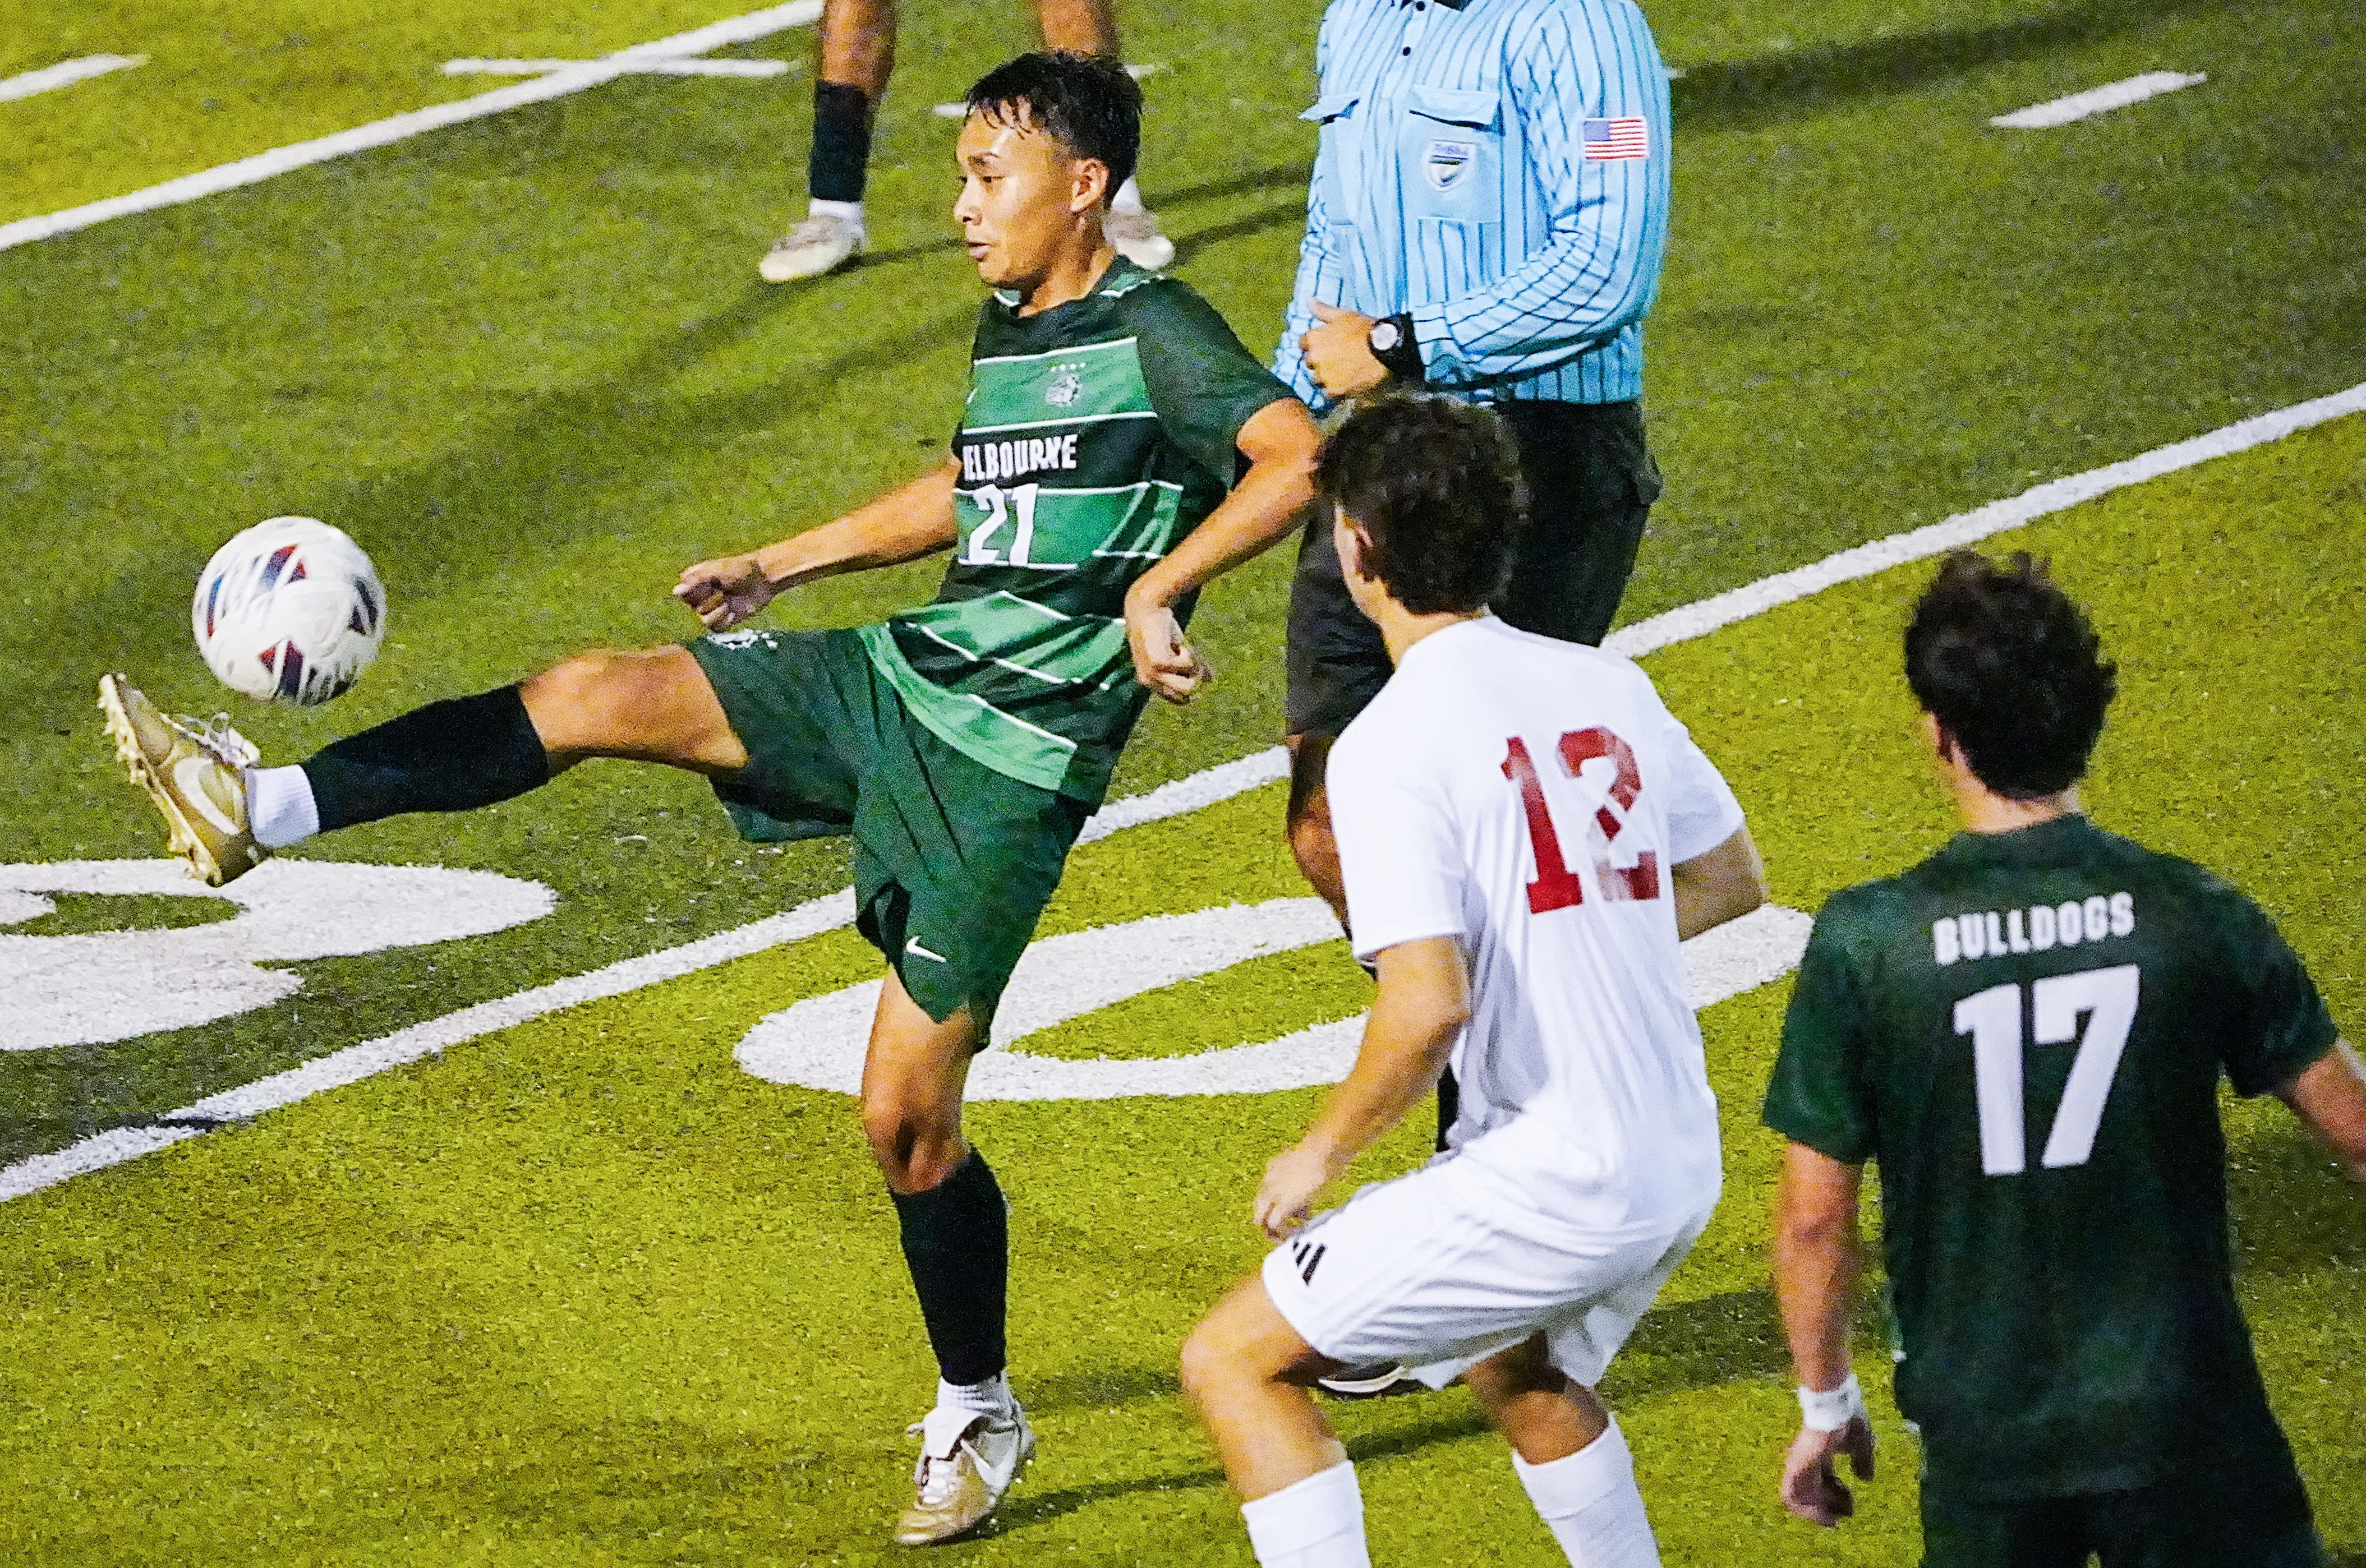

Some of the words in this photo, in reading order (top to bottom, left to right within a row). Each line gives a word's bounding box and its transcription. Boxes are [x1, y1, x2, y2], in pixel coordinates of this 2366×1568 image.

[969, 483, 1038, 566] 21
[1500, 726, 1660, 914] 12
[1933, 892, 2135, 966] BULLDOGS
[1953, 964, 2140, 1175] 17
